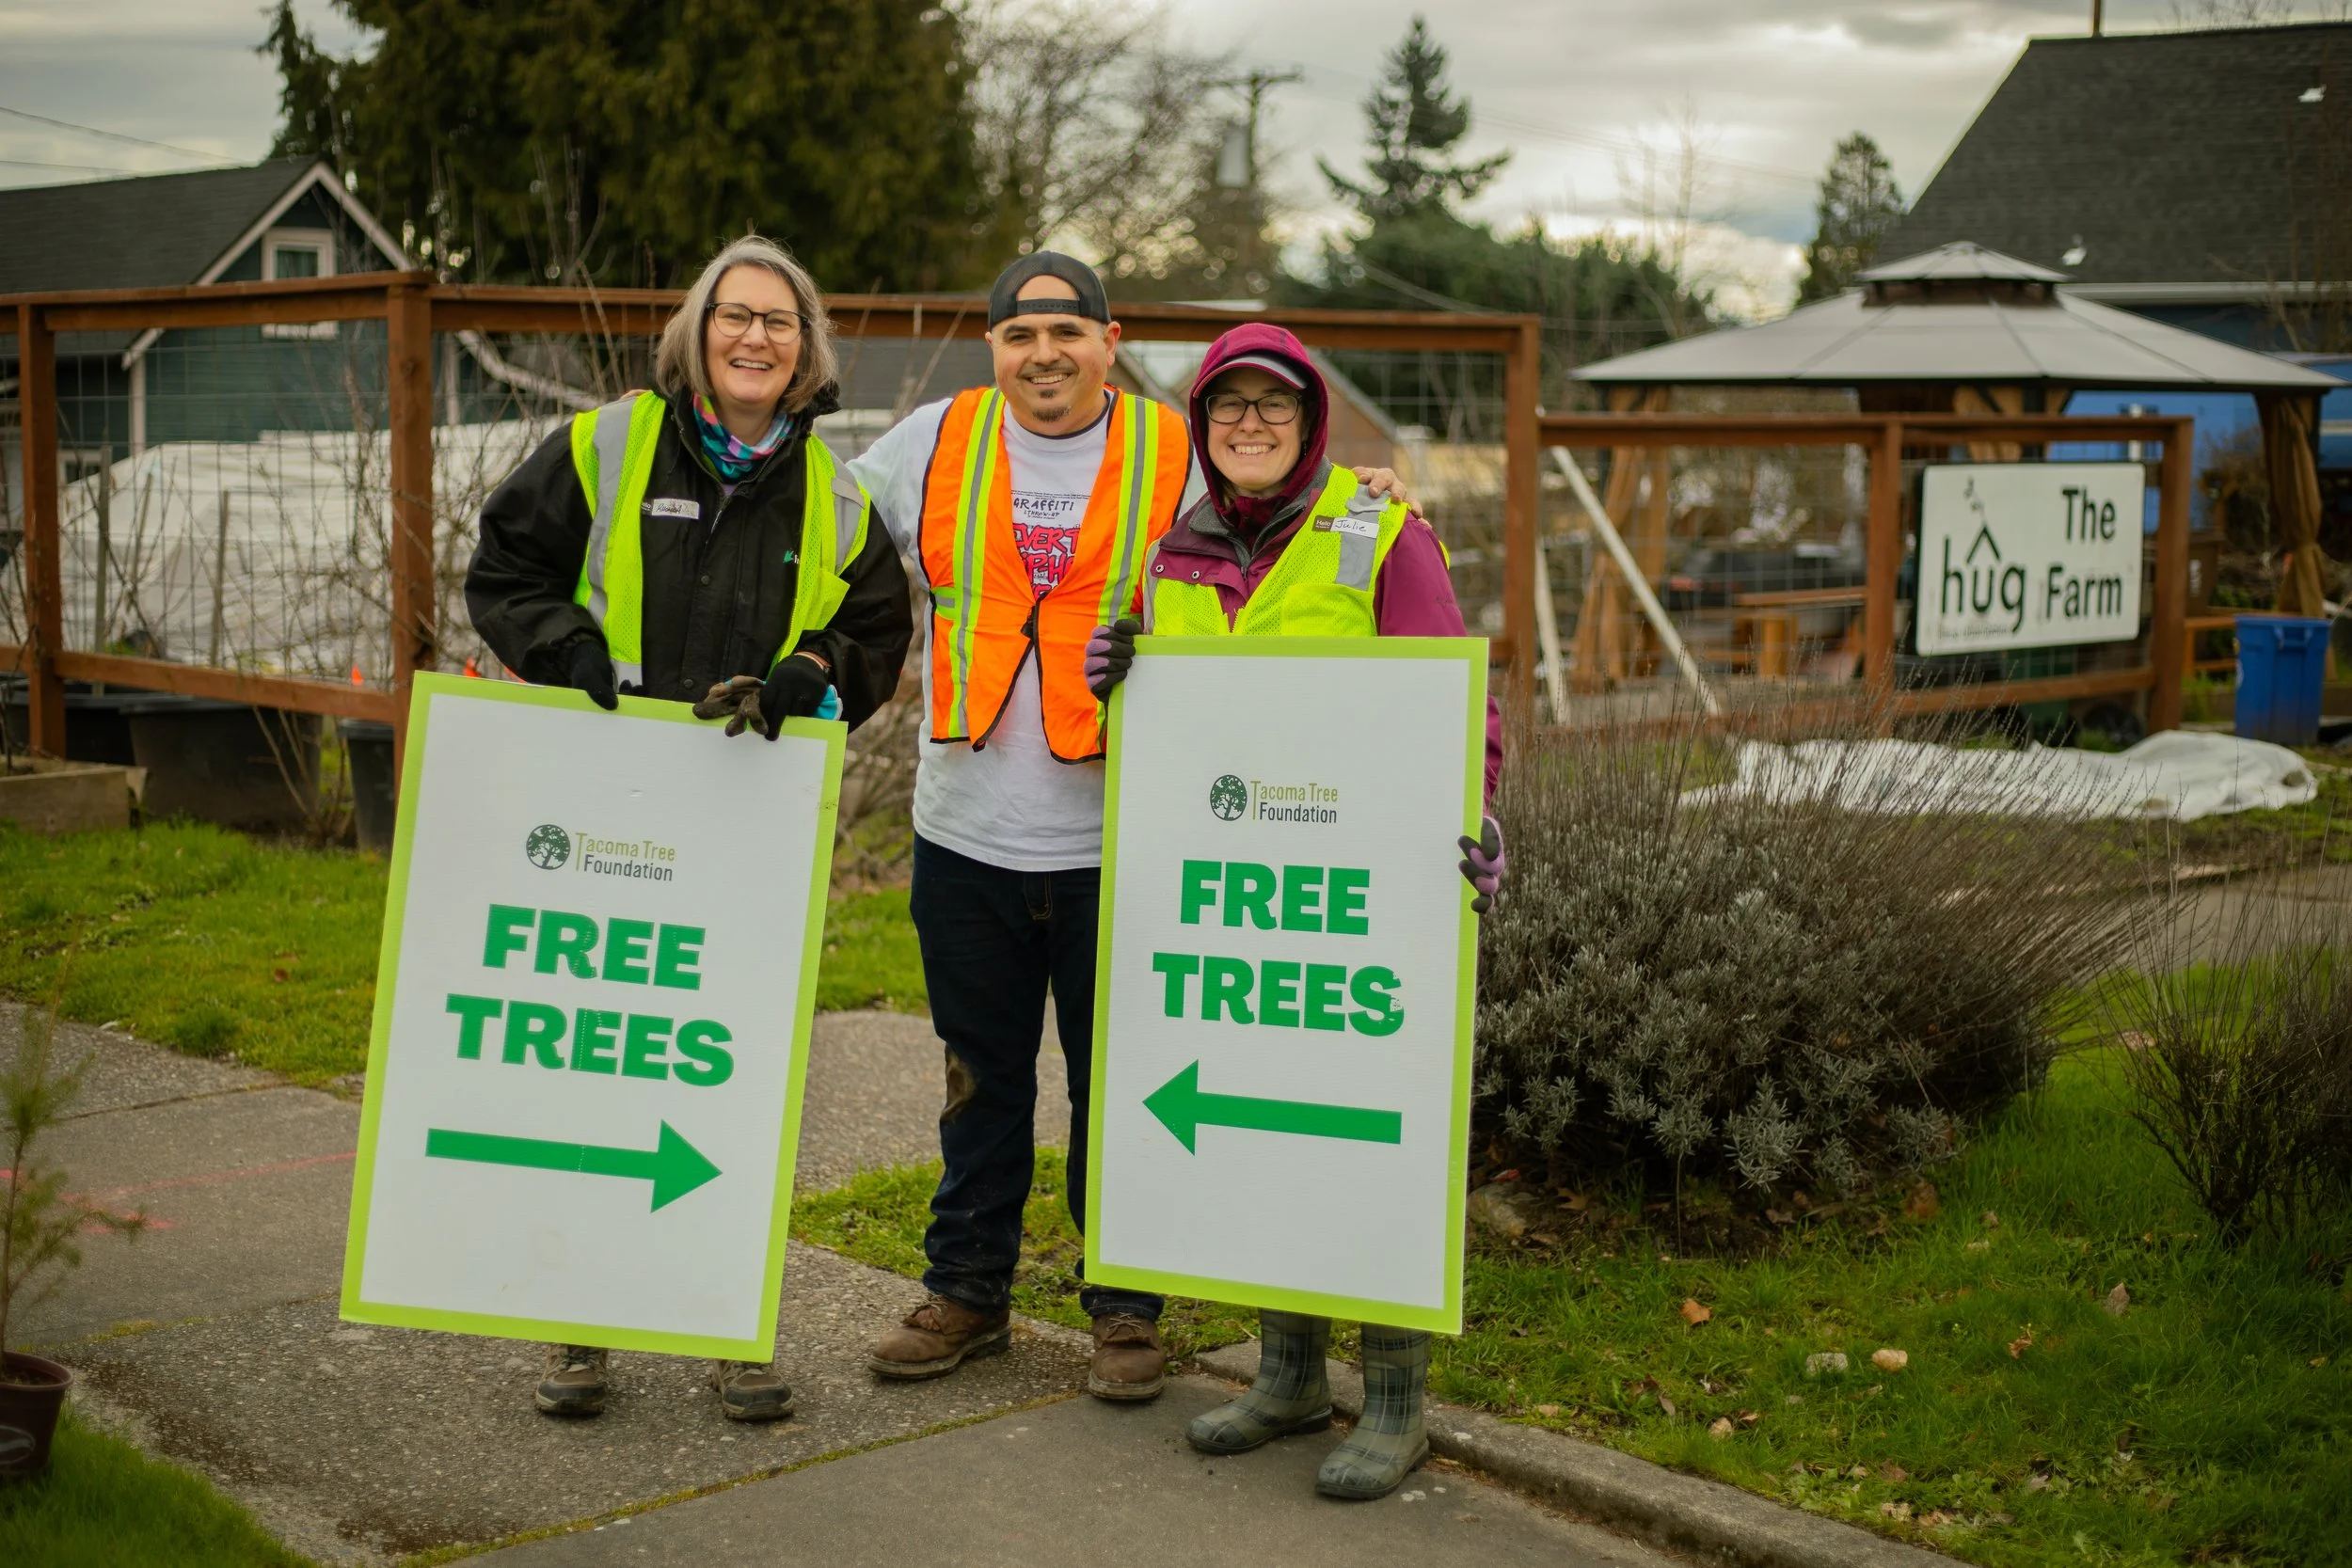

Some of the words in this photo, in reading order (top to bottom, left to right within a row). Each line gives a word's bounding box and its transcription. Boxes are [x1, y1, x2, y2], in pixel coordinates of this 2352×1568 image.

[1013, 498, 1074, 511] GRAFFITI
[1335, 519, 1367, 532] Julie
[2062, 484, 2117, 543] The
[1942, 534, 2026, 634] hug
[2045, 562, 2123, 619] Farm
[1250, 780, 1306, 820] Tacoma
[1309, 783, 1339, 802] Tree
[1259, 802, 1337, 824] Foundation
[575, 832, 640, 871] Tacoma
[643, 840, 675, 862] Tree
[583, 854, 674, 881] Foundation
[1180, 859, 1371, 936] FREE
[483, 903, 707, 991] FREE
[1152, 951, 1405, 1037] TREES
[445, 992, 735, 1087] TREES
